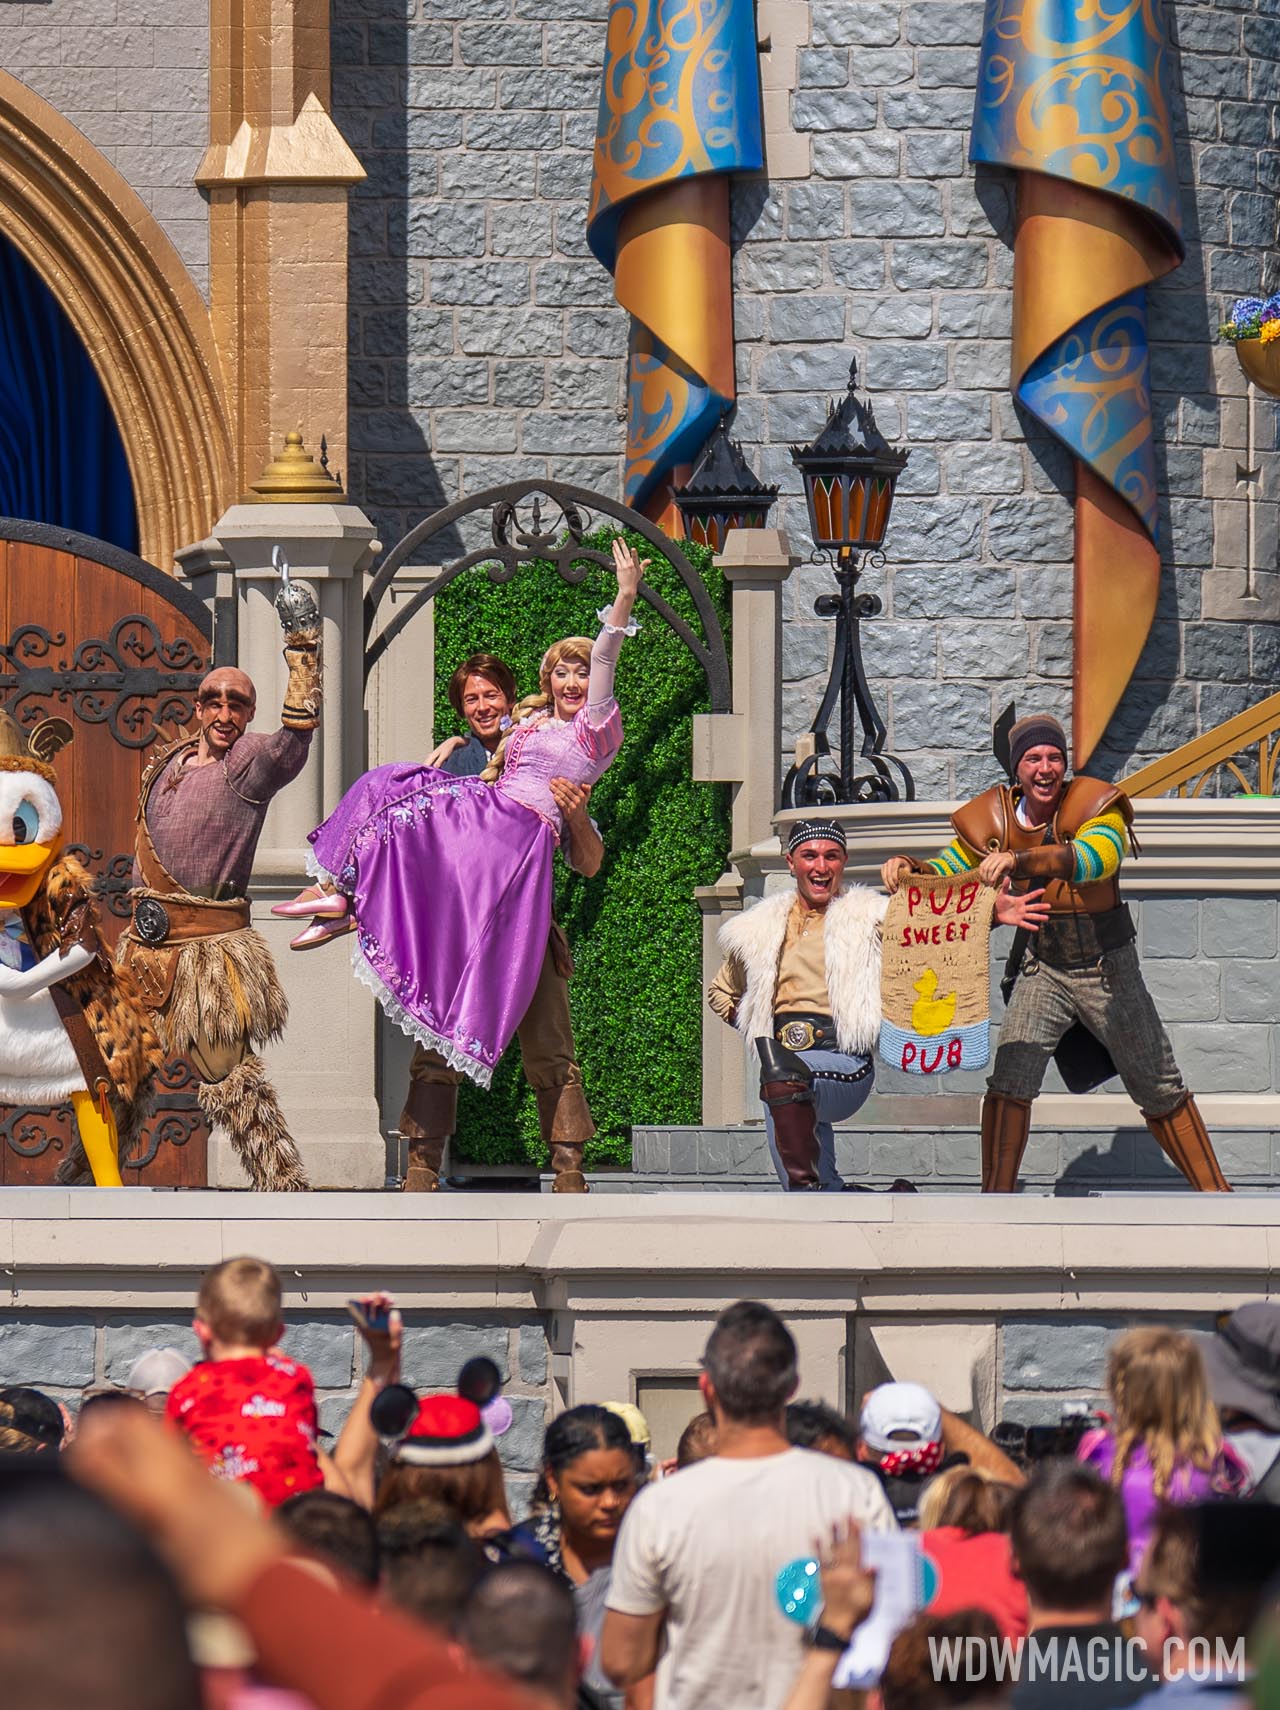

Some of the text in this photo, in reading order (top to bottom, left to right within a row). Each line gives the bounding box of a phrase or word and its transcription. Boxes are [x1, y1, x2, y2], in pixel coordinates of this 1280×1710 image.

[908, 880, 979, 917] PUB
[901, 921, 970, 947] SWEET
[901, 1038, 962, 1073] PUB
